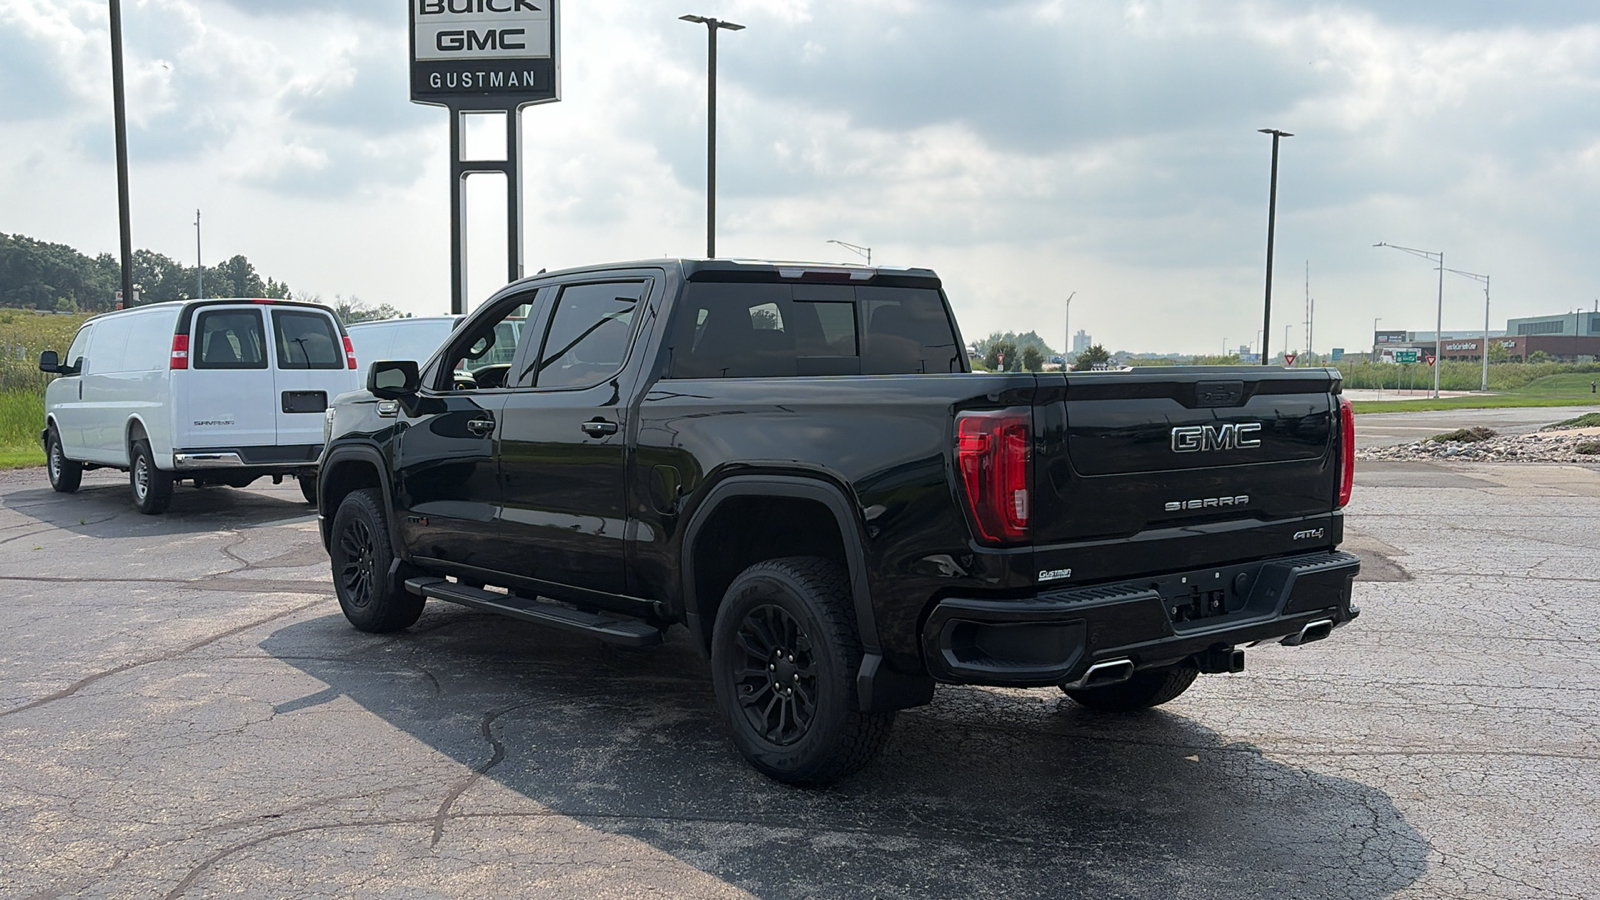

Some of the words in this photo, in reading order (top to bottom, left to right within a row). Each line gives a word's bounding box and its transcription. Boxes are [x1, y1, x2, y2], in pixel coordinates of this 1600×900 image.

[436, 28, 526, 51] GMC
[429, 70, 534, 88] GUSTMAN
[1171, 422, 1262, 453] GMC
[1164, 495, 1250, 511] SIERRA
[1293, 527, 1325, 541] AT4
